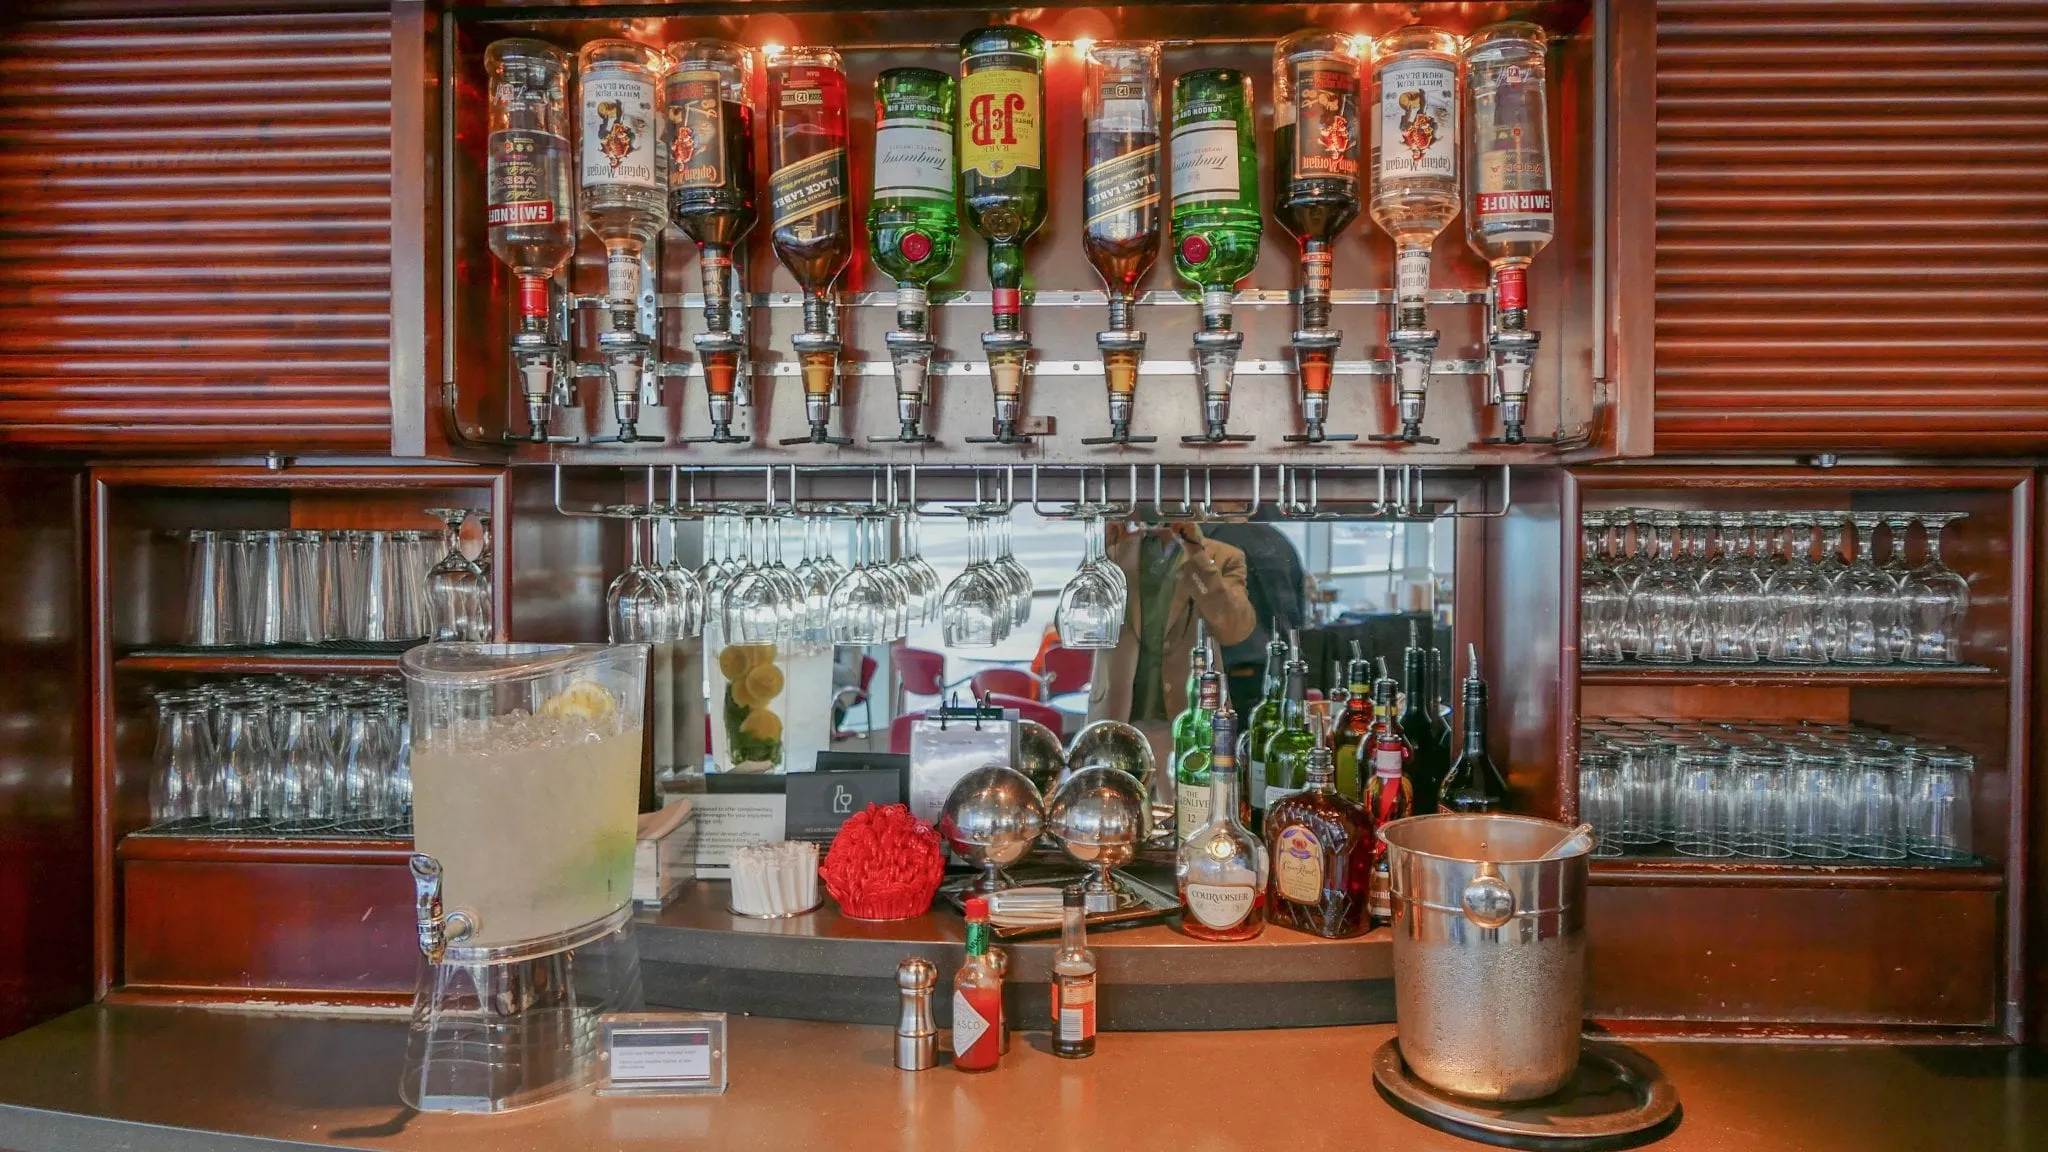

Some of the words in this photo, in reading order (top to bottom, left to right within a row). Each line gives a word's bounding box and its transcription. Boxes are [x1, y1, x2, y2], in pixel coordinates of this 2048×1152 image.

[1395, 72, 1421, 80] BLANC
[1422, 72, 1444, 80] RHUM
[1418, 79, 1443, 88] WHITE
[595, 90, 612, 98] RUM
[797, 93, 807, 102] 12
[1119, 87, 1128, 96] 12
[887, 104, 898, 112] GIN
[916, 103, 944, 114] LONDON
[1193, 105, 1222, 116] LONDON
[969, 93, 1025, 146] J&B
[881, 152, 947, 171] Tanqueray
[1301, 155, 1339, 174] Morgan
[1385, 156, 1419, 174] Morgan
[1421, 156, 1451, 173] Captain
[586, 164, 616, 180] Morgan
[618, 164, 650, 181] Captain
[685, 163, 717, 182] Captain
[805, 175, 839, 195] BLACK
[1122, 173, 1156, 192] BLACK
[772, 188, 804, 209] LABEL
[1087, 185, 1121, 205] LABEL
[1308, 264, 1330, 276] organ
[1401, 263, 1427, 276] Morgan
[1402, 276, 1427, 291] Captain
[1186, 790, 1199, 799] THE
[1187, 814, 1196, 823] 12
[1192, 890, 1249, 904] COURVOISIER
[956, 1020, 981, 1030] ASCO
